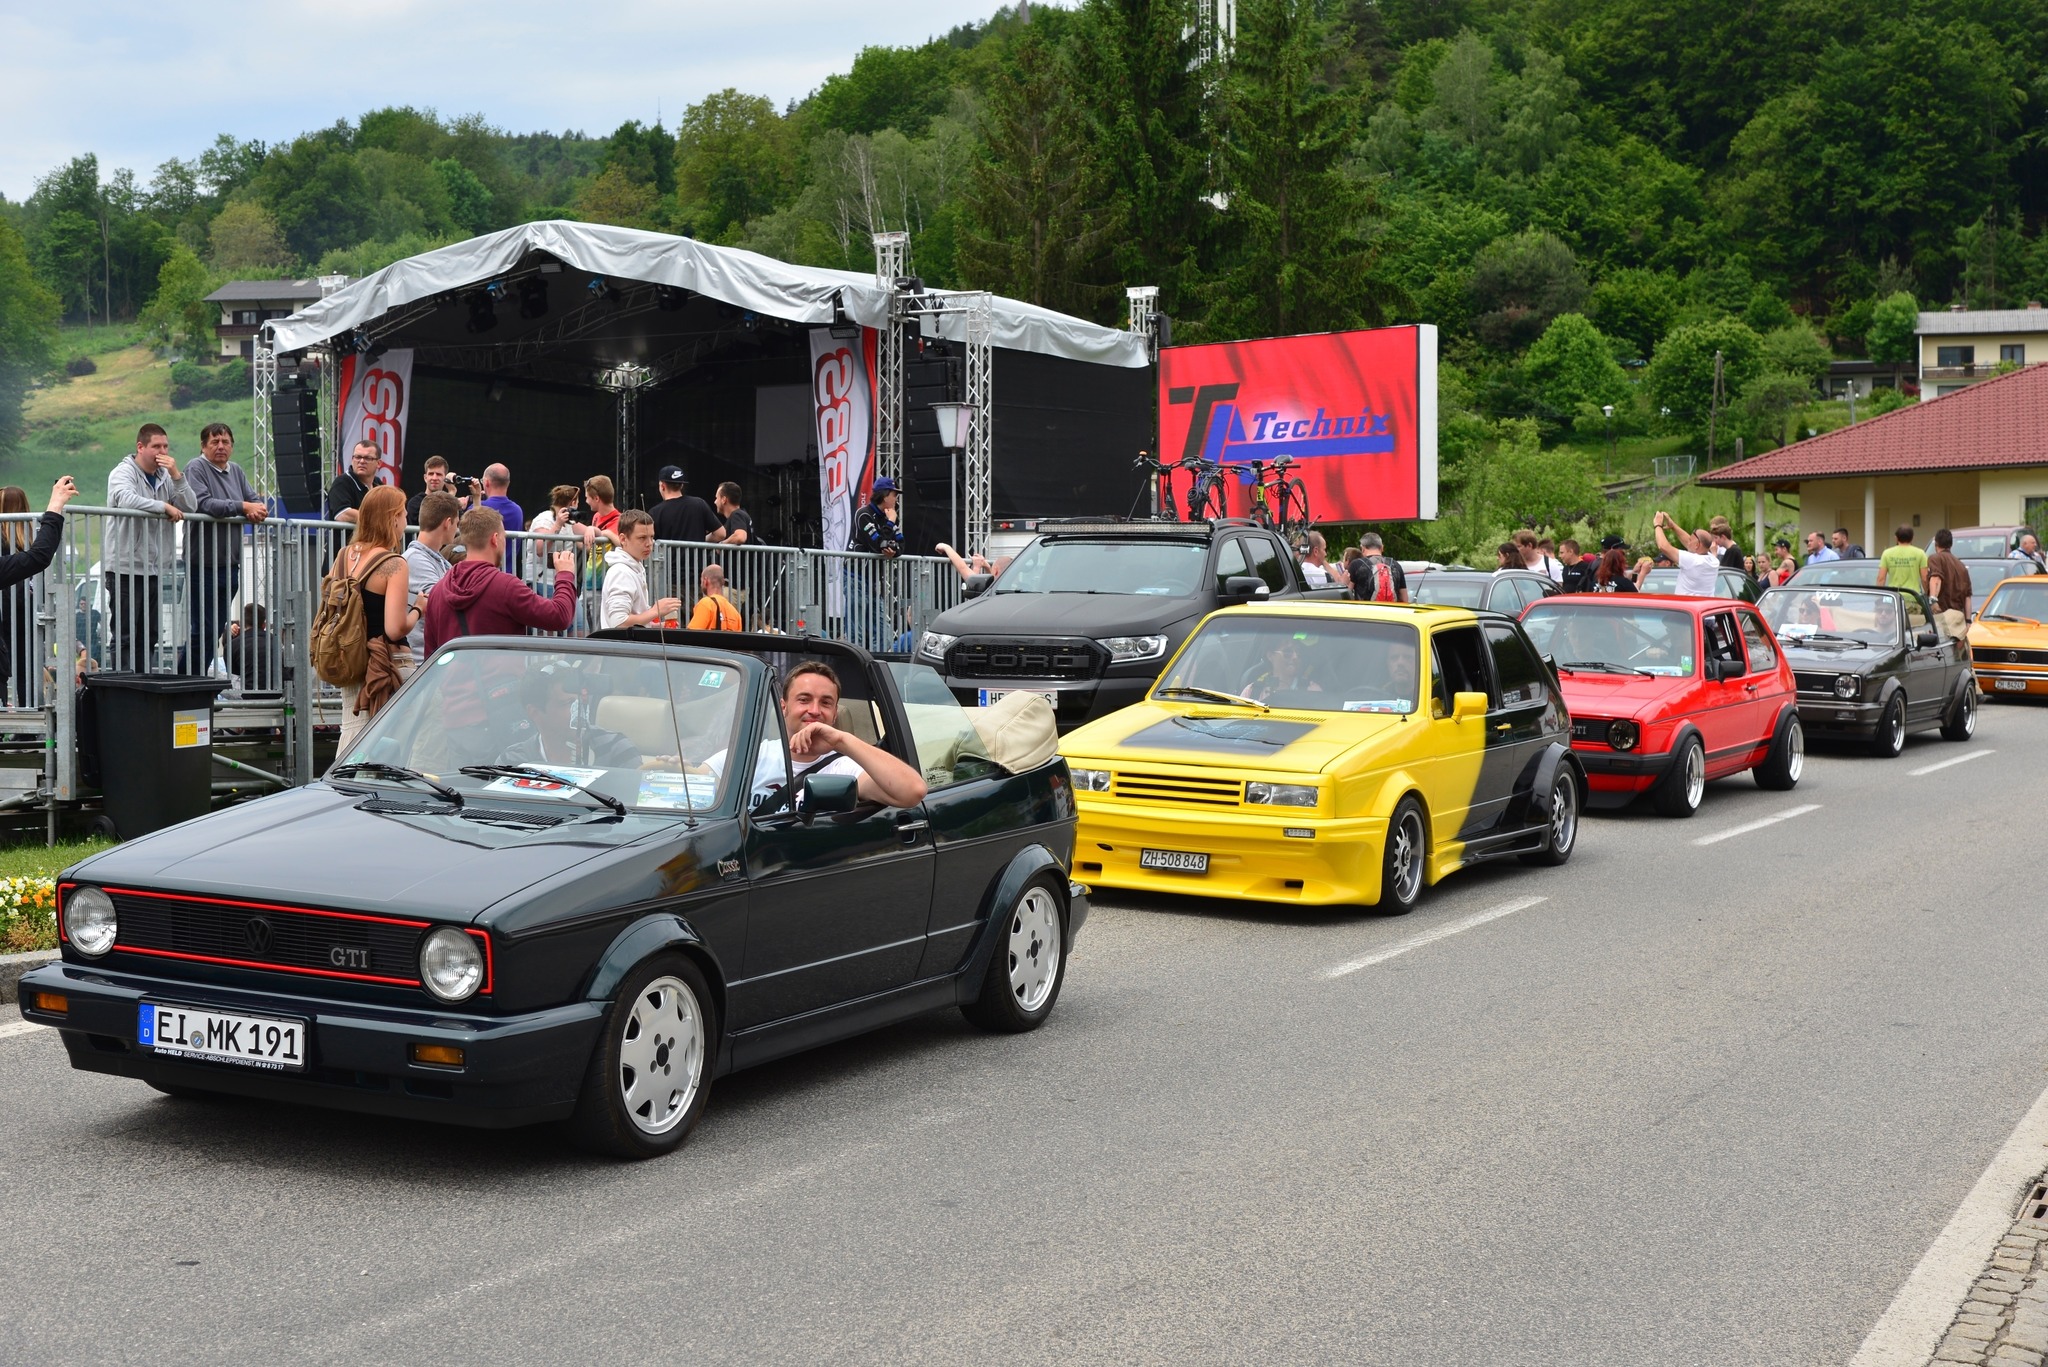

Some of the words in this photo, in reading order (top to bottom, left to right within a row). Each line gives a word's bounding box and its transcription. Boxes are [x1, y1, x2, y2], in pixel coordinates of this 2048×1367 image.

[361, 368, 403, 487] BS
[1252, 407, 1391, 441] Technix
[956, 653, 1090, 669] FORD
[330, 947, 368, 969] GTI
[158, 1011, 188, 1045] EI
[207, 1017, 242, 1053] MK
[248, 1023, 299, 1060] 191
